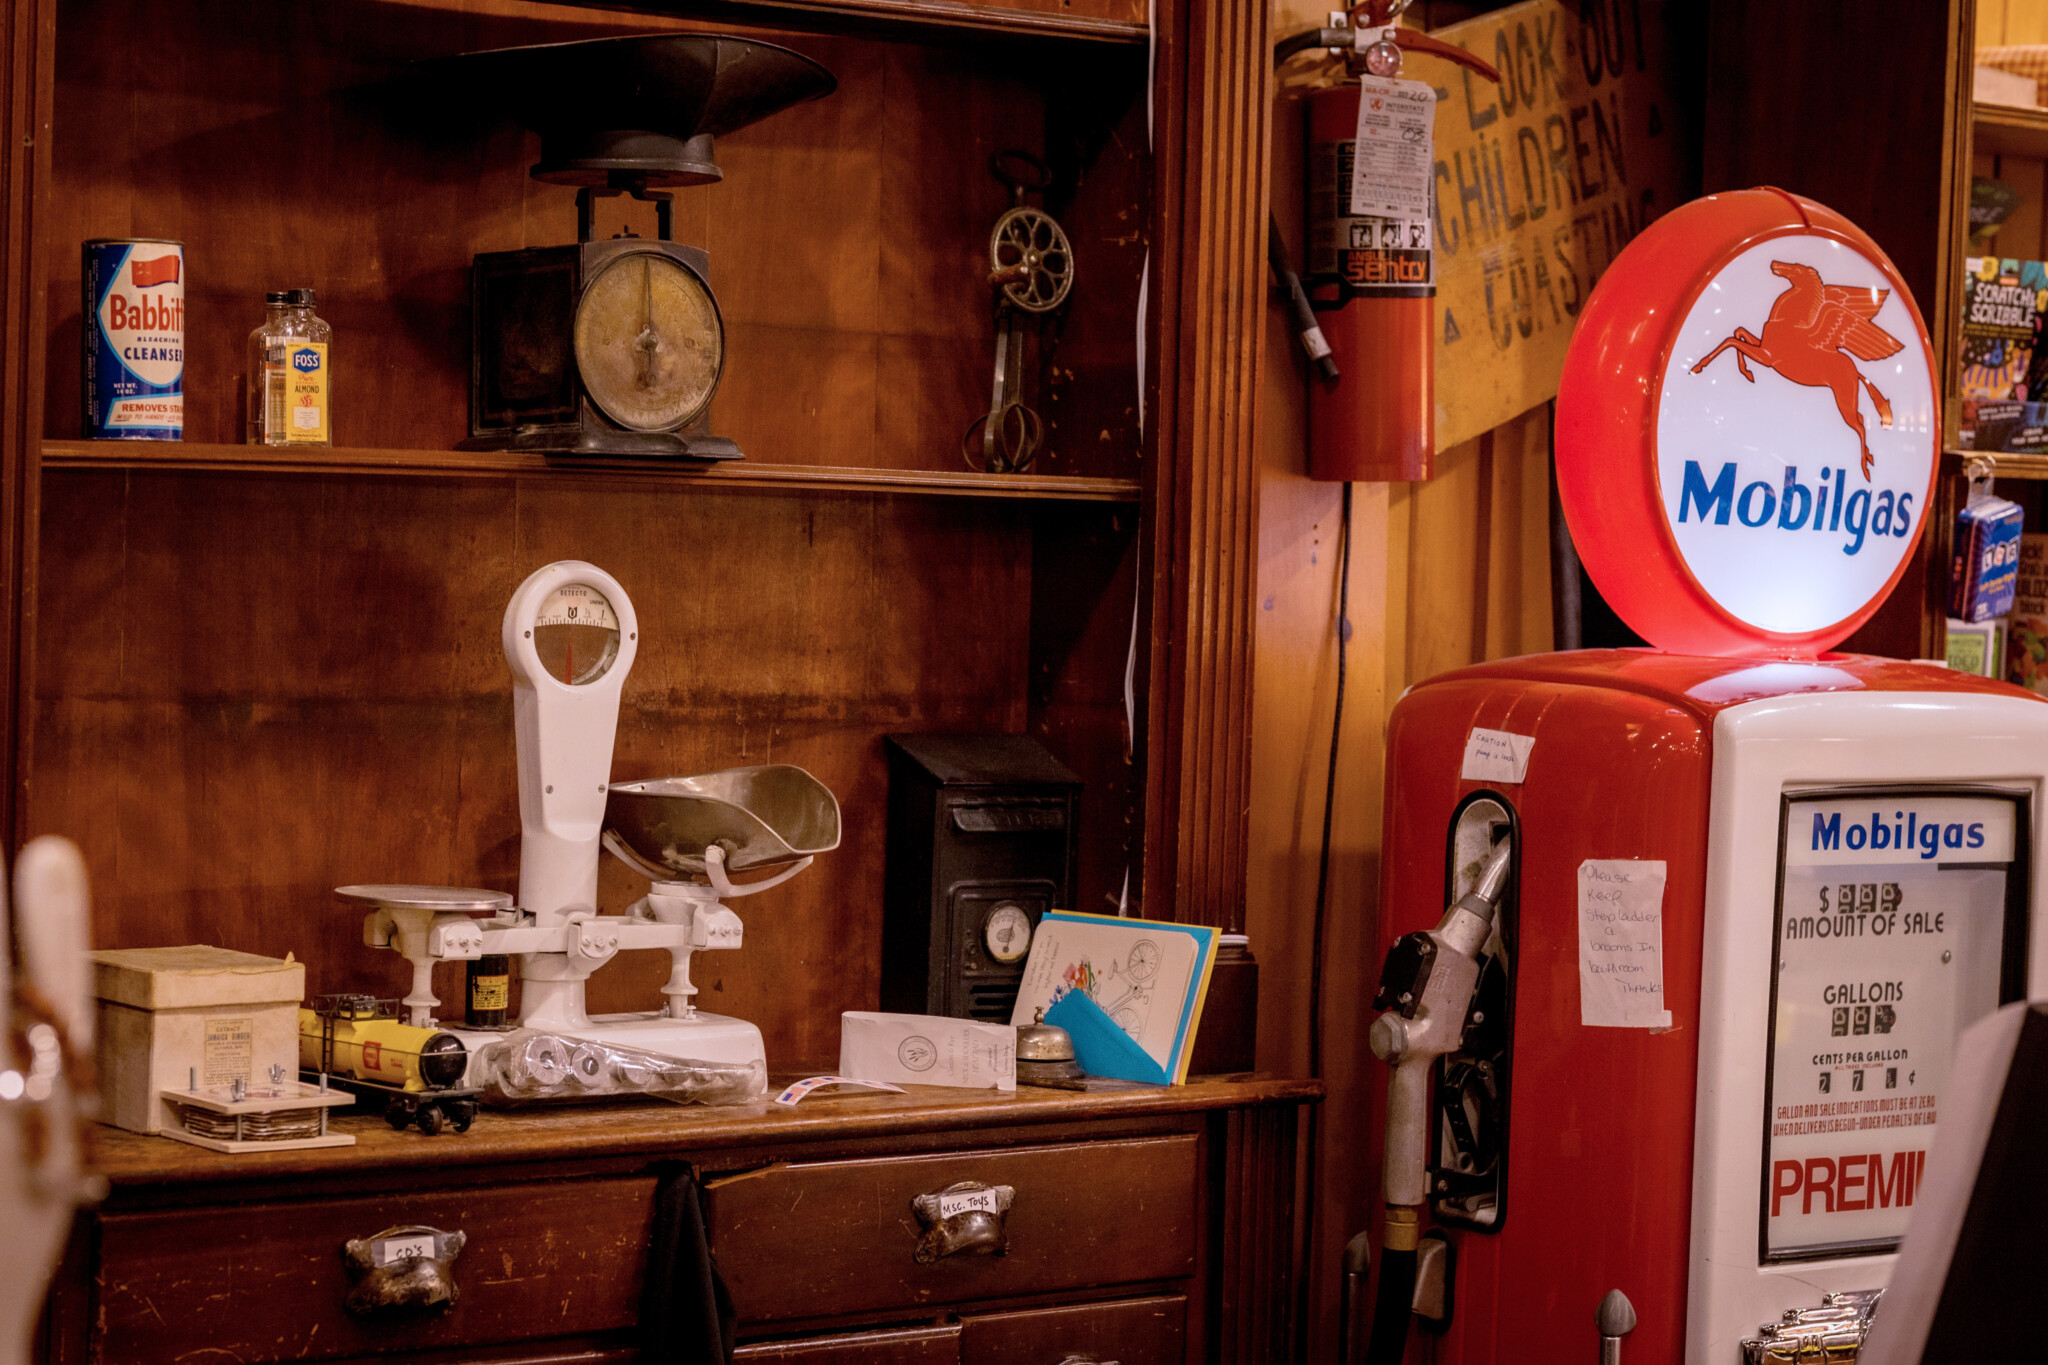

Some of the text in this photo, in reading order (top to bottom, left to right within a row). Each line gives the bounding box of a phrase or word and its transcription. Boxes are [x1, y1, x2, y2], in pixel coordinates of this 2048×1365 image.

[1347, 255, 1427, 281] sentry
[1970, 303, 2034, 328] SCRIBBLE
[137, 336, 179, 344] BLEACHING
[295, 385, 319, 394] ALMOND
[122, 403, 168, 413] REMOVES
[1677, 459, 1913, 556] Mobilgas
[1476, 734, 1507, 748] CAUTION
[1811, 811, 1985, 859] Mobilgas
[1584, 864, 1633, 883] Please
[1786, 912, 1945, 939] AMOUNT OF SALE
[1590, 942, 1633, 953] brooms
[1823, 980, 1903, 1005] GALLONS
[1812, 1048, 1909, 1066] CENTS PER GALLON
[1777, 1094, 1936, 1120] GALLON AND SALE INDICATIONS MUST BE AT ZERO
[1773, 1122, 1794, 1137] WHEN
[1794, 1119, 1827, 1136] DELIVERY
[1827, 1118, 1834, 1133] IS
[1881, 1112, 1913, 1129] PENALTY
[1913, 1111, 1923, 1126] OF
[1922, 1110, 1937, 1126] LAW
